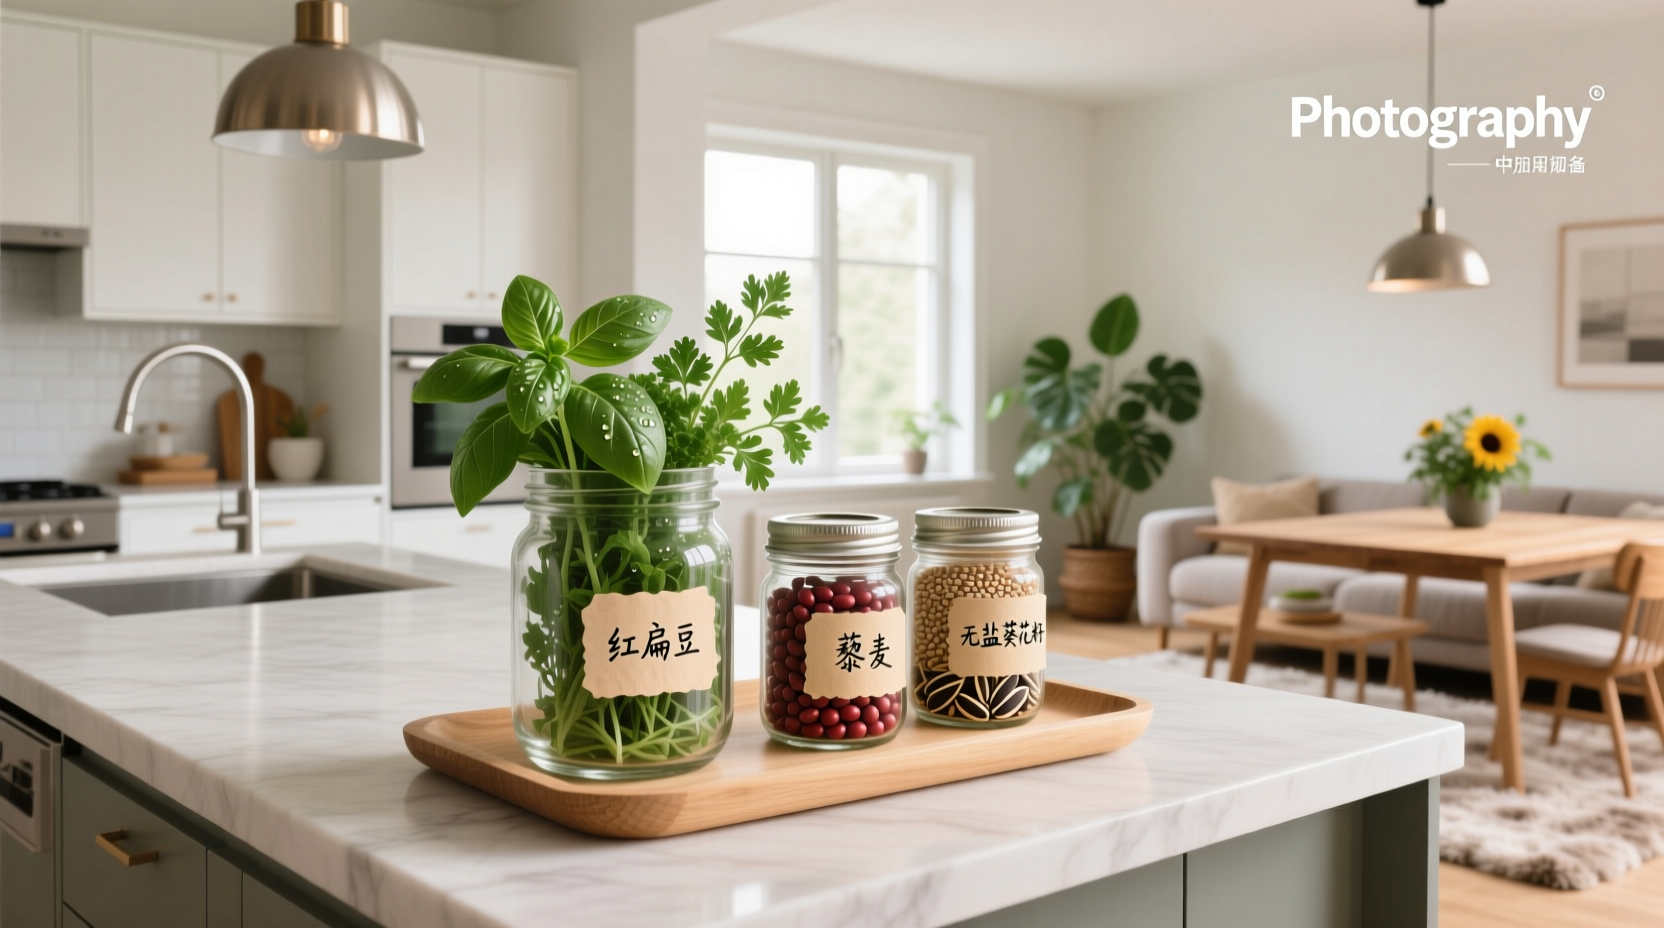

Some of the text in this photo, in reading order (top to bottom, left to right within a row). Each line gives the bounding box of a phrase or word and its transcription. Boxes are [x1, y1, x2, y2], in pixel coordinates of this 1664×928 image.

[607, 621, 700, 663] 红扁豆
[835, 631, 893, 673] 藜麦
